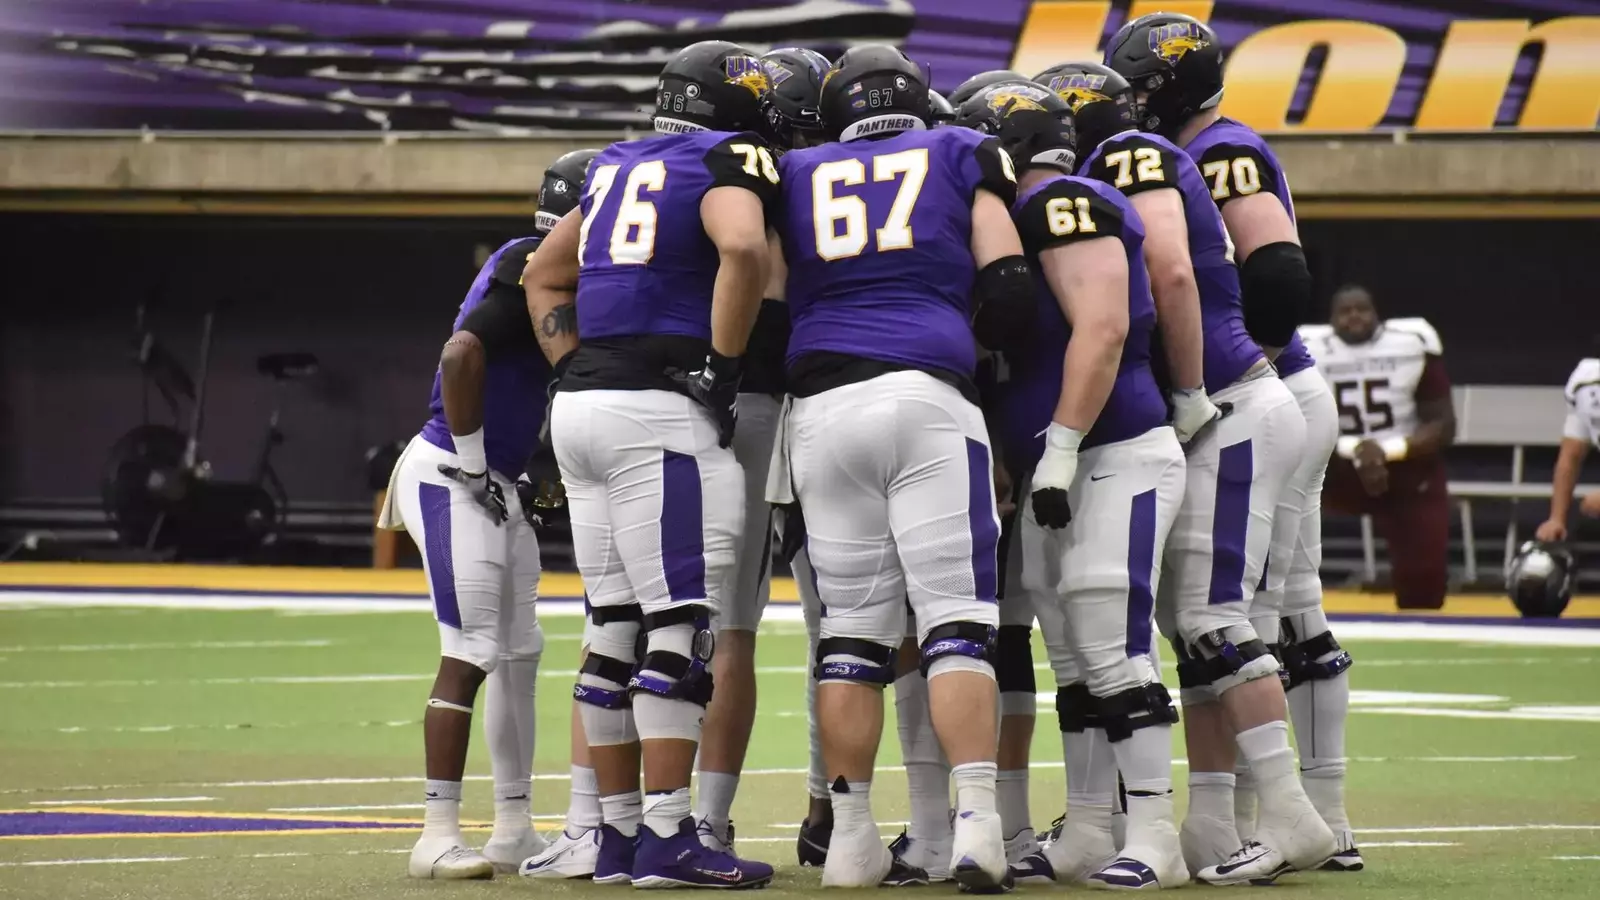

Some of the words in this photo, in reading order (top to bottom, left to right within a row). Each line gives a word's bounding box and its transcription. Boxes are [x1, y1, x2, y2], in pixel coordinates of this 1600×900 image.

[662, 92, 684, 112] 76
[869, 88, 893, 107] 67
[655, 119, 705, 134] PANTHER
[856, 118, 915, 135] PANTHERS
[729, 144, 781, 184] 76
[1105, 148, 1165, 188] 72
[1203, 157, 1261, 200] 70
[577, 160, 667, 266] 76
[811, 148, 929, 261] 67
[1045, 197, 1097, 236] 61
[1334, 379, 1394, 435] 55
